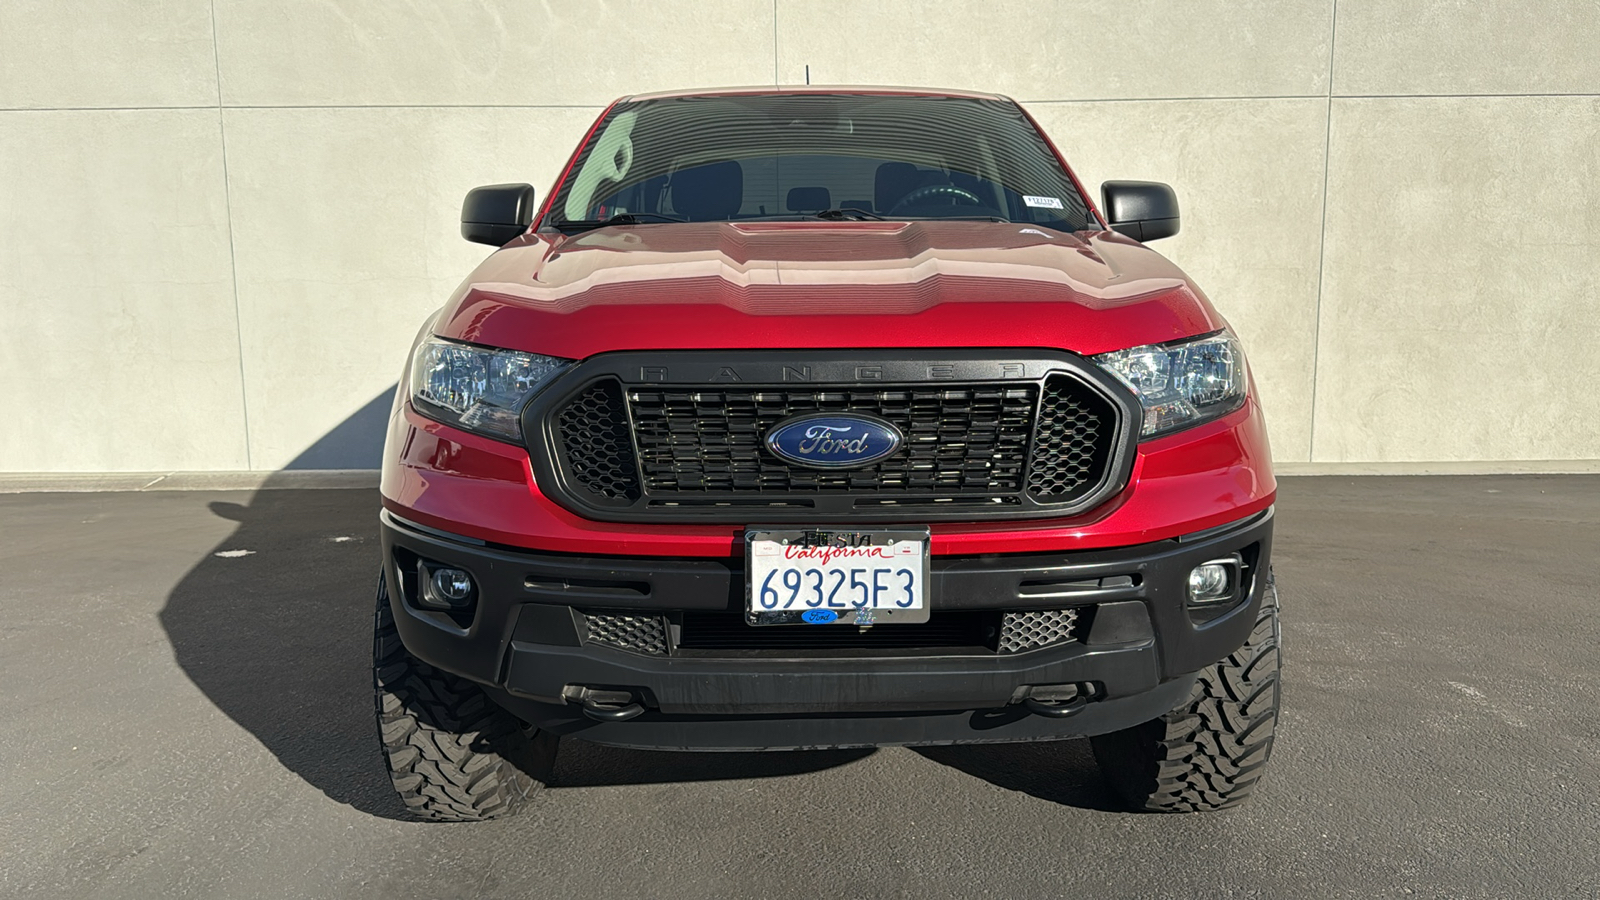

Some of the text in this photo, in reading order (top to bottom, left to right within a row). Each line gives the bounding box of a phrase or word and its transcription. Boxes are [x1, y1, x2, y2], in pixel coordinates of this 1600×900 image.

[640, 363, 1026, 381] RANGER
[799, 425, 869, 454] Ford
[802, 529, 872, 549] FIESTA
[785, 544, 894, 565] California
[760, 568, 914, 608] 69325F3
[808, 611, 830, 622] Ford
